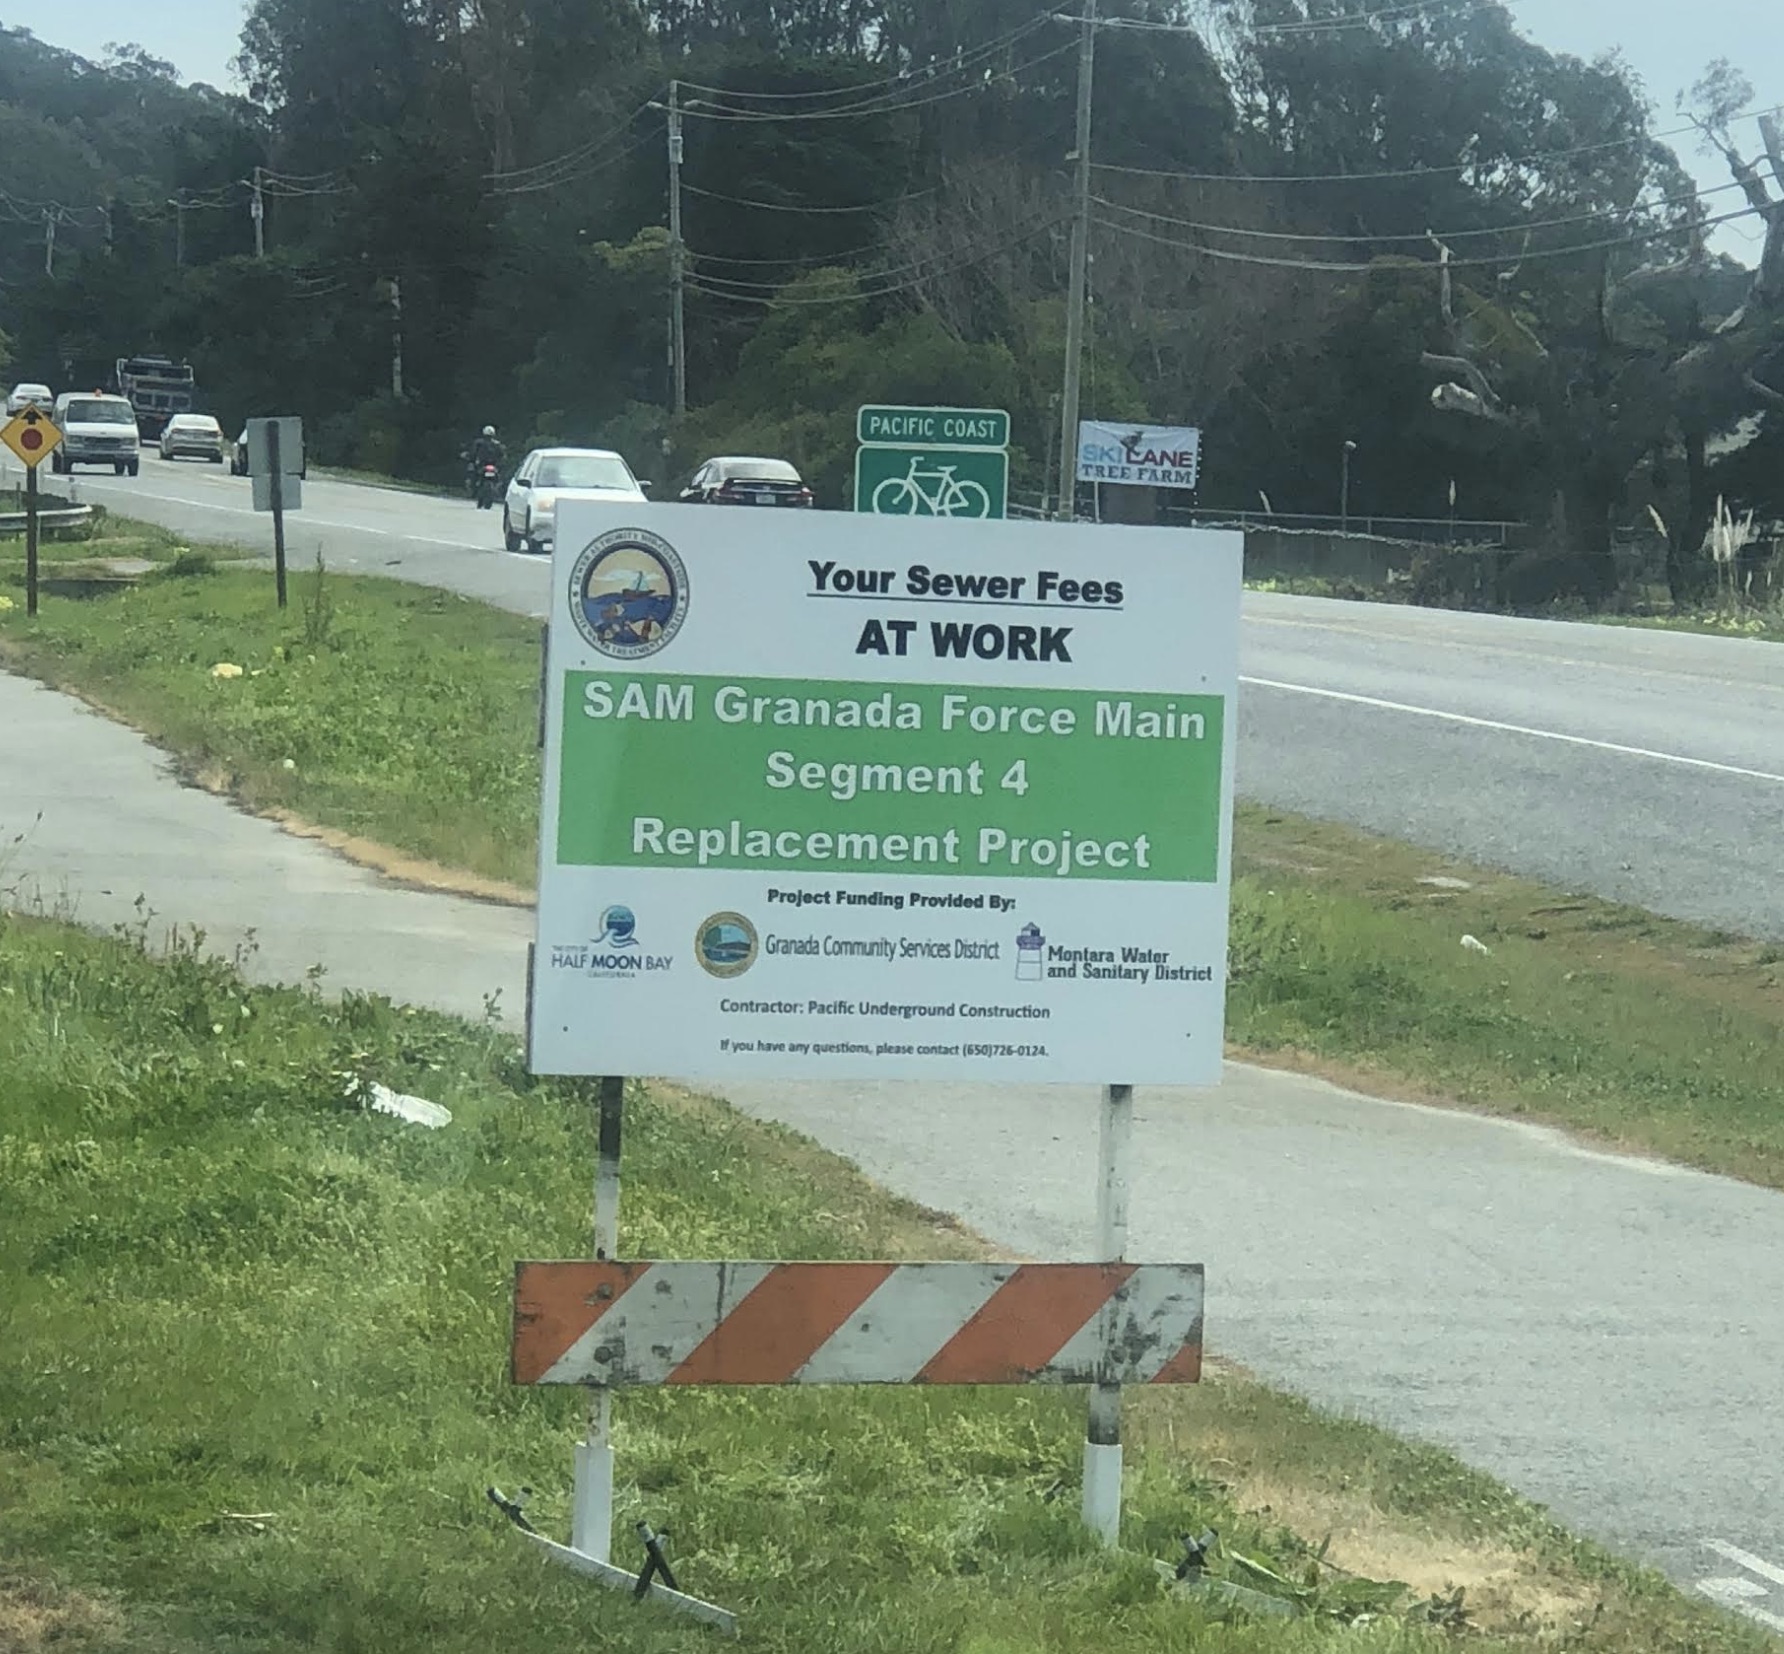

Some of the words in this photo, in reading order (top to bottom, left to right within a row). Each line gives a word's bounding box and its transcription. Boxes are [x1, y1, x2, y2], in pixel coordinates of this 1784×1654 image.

[870, 416, 934, 436] PACIFIC
[944, 418, 997, 438] COAST
[1082, 463, 1131, 479] TREE
[1137, 467, 1193, 484] FARM
[808, 560, 896, 593] Your
[906, 565, 1026, 599] Sewer
[1037, 571, 1124, 604] Fees
[855, 619, 917, 656] AT
[930, 621, 1074, 662] WORK
[583, 681, 694, 721] SAM
[714, 685, 922, 729] Granada
[942, 694, 1077, 735] Force
[1095, 701, 1205, 739] Main
[765, 751, 984, 800] Segment
[1000, 759, 1029, 796] 4
[632, 817, 960, 864] Replacement
[978, 828, 1151, 876] Project
[767, 888, 831, 907] Project
[836, 890, 904, 910] Funding
[909, 893, 984, 909] Provided
[989, 895, 1016, 912] By:
[766, 934, 820, 956] Granada
[823, 935, 896, 962] Community
[899, 937, 951, 958] Services
[954, 939, 1000, 960] District
[1047, 945, 1115, 963] Montara
[1121, 947, 1170, 963] Water
[551, 954, 588, 968] HALF
[591, 955, 642, 969] MOON
[646, 955, 673, 970] BAY
[1047, 964, 1077, 978] and
[1082, 963, 1150, 984] Sanitary
[1155, 965, 1213, 981] District
[720, 999, 804, 1014] Contractor:
[807, 1000, 855, 1015] Pacific
[859, 1002, 955, 1019] Underground
[959, 1003, 1051, 1019] Construction
[720, 1039, 730, 1050] If
[732, 1041, 754, 1053] you
[757, 1040, 785, 1051] have
[788, 1042, 809, 1054] any
[812, 1041, 873, 1055] questions,
[876, 1043, 914, 1055] please
[916, 1044, 959, 1055] contact
